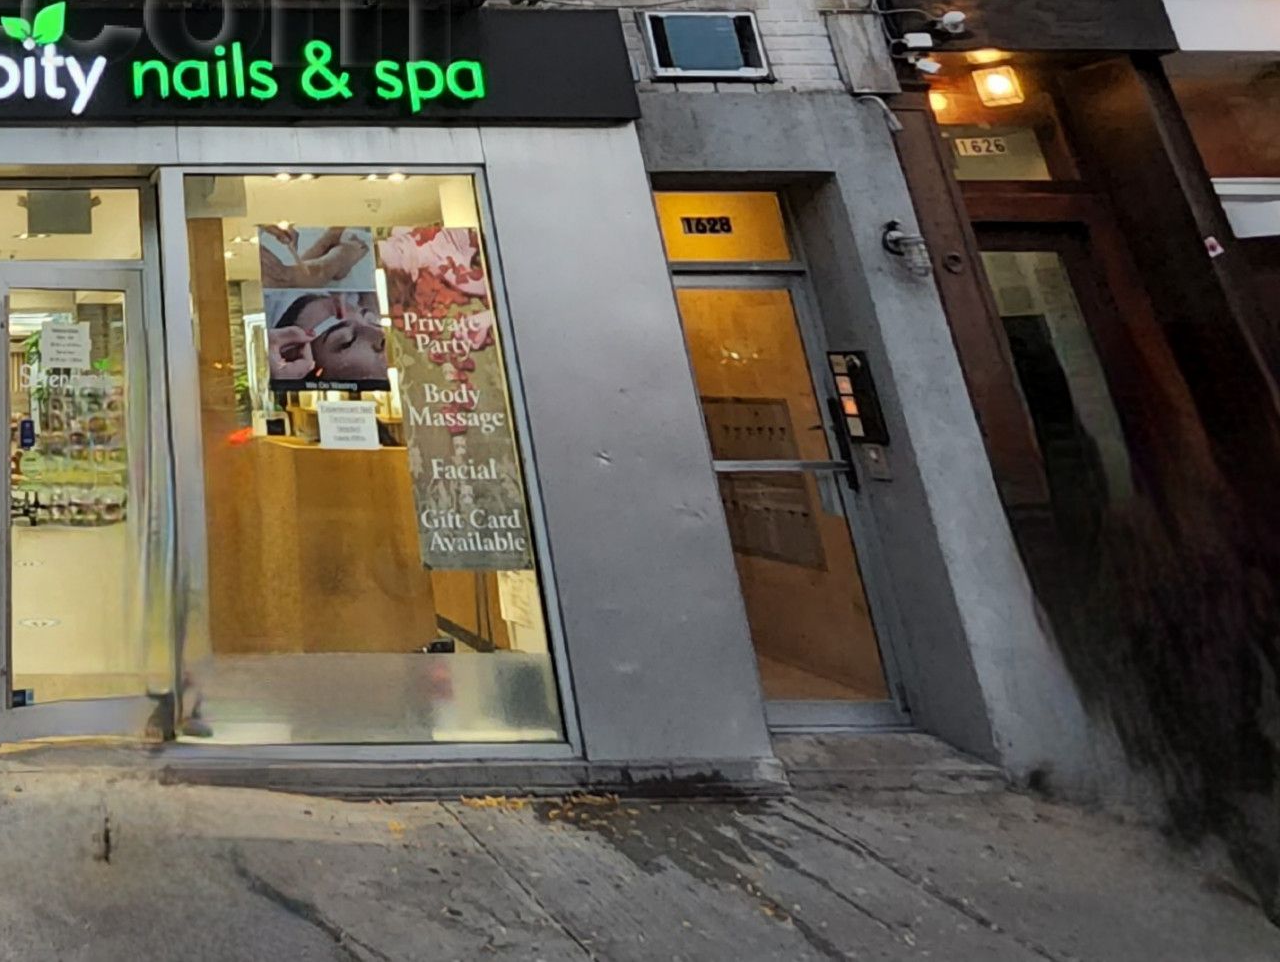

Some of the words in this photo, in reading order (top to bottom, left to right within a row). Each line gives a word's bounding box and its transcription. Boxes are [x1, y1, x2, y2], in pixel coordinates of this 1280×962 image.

[132, 41, 278, 100] nails
[300, 40, 354, 100] &
[375, 59, 486, 113] spa
[960, 138, 1006, 154] 1626
[680, 216, 733, 234] 1628
[403, 312, 483, 333] Private
[415, 333, 473, 362] Party
[423, 383, 480, 411] Body
[408, 405, 505, 434] Massage
[431, 458, 498, 480] Facial
[420, 508, 463, 529] Gift
[469, 508, 523, 529] Card
[429, 531, 527, 552] Available
